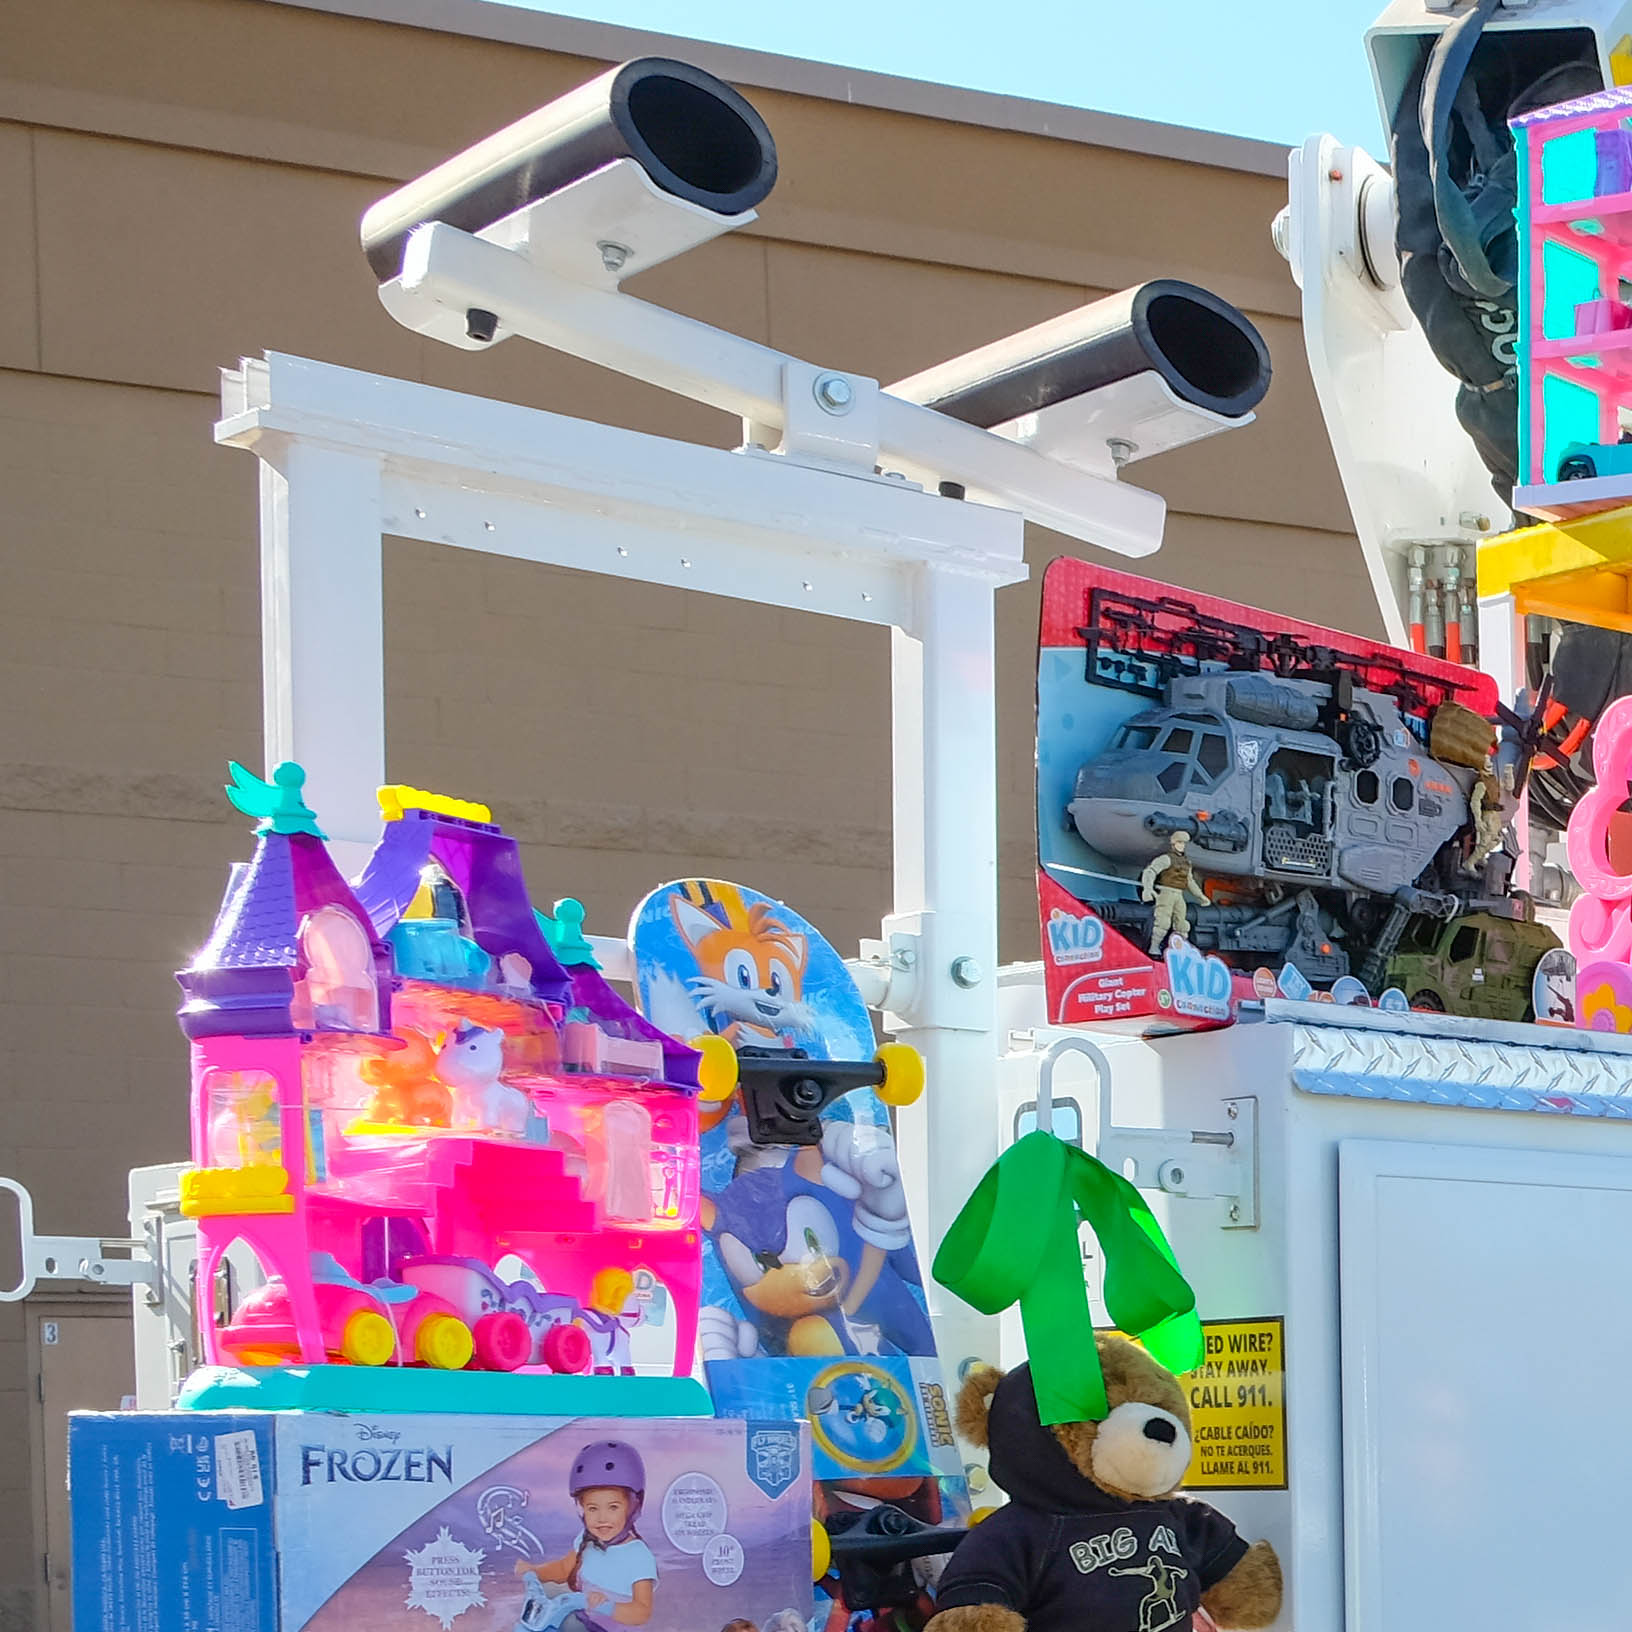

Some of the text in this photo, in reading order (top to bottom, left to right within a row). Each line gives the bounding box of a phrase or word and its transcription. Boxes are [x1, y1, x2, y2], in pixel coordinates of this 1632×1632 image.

[1051, 920, 1101, 951] KID
[1098, 978, 1124, 988] Giant
[1167, 950, 1228, 999] KID
[1078, 987, 1147, 1004] Military Copter
[1094, 1002, 1131, 1015] Play Set
[45, 1324, 56, 1342] 3
[1228, 1332, 1273, 1352] WIRE?
[1226, 1359, 1272, 1378] AWAY.
[1190, 1384, 1273, 1409] CALL 911.
[926, 1383, 955, 1447] SONIC
[353, 1423, 401, 1445] Disney
[1194, 1421, 1275, 1443] ¿CABLE CAÍDO?
[1200, 1443, 1273, 1458] NO TE ACERQUES.
[300, 1444, 454, 1486] FROZEN
[1201, 1459, 1274, 1475] LLAME AL 911.
[1069, 1527, 1138, 1574] BIG
[431, 1556, 460, 1566] PRESS
[416, 1567, 452, 1577] BUTTON
